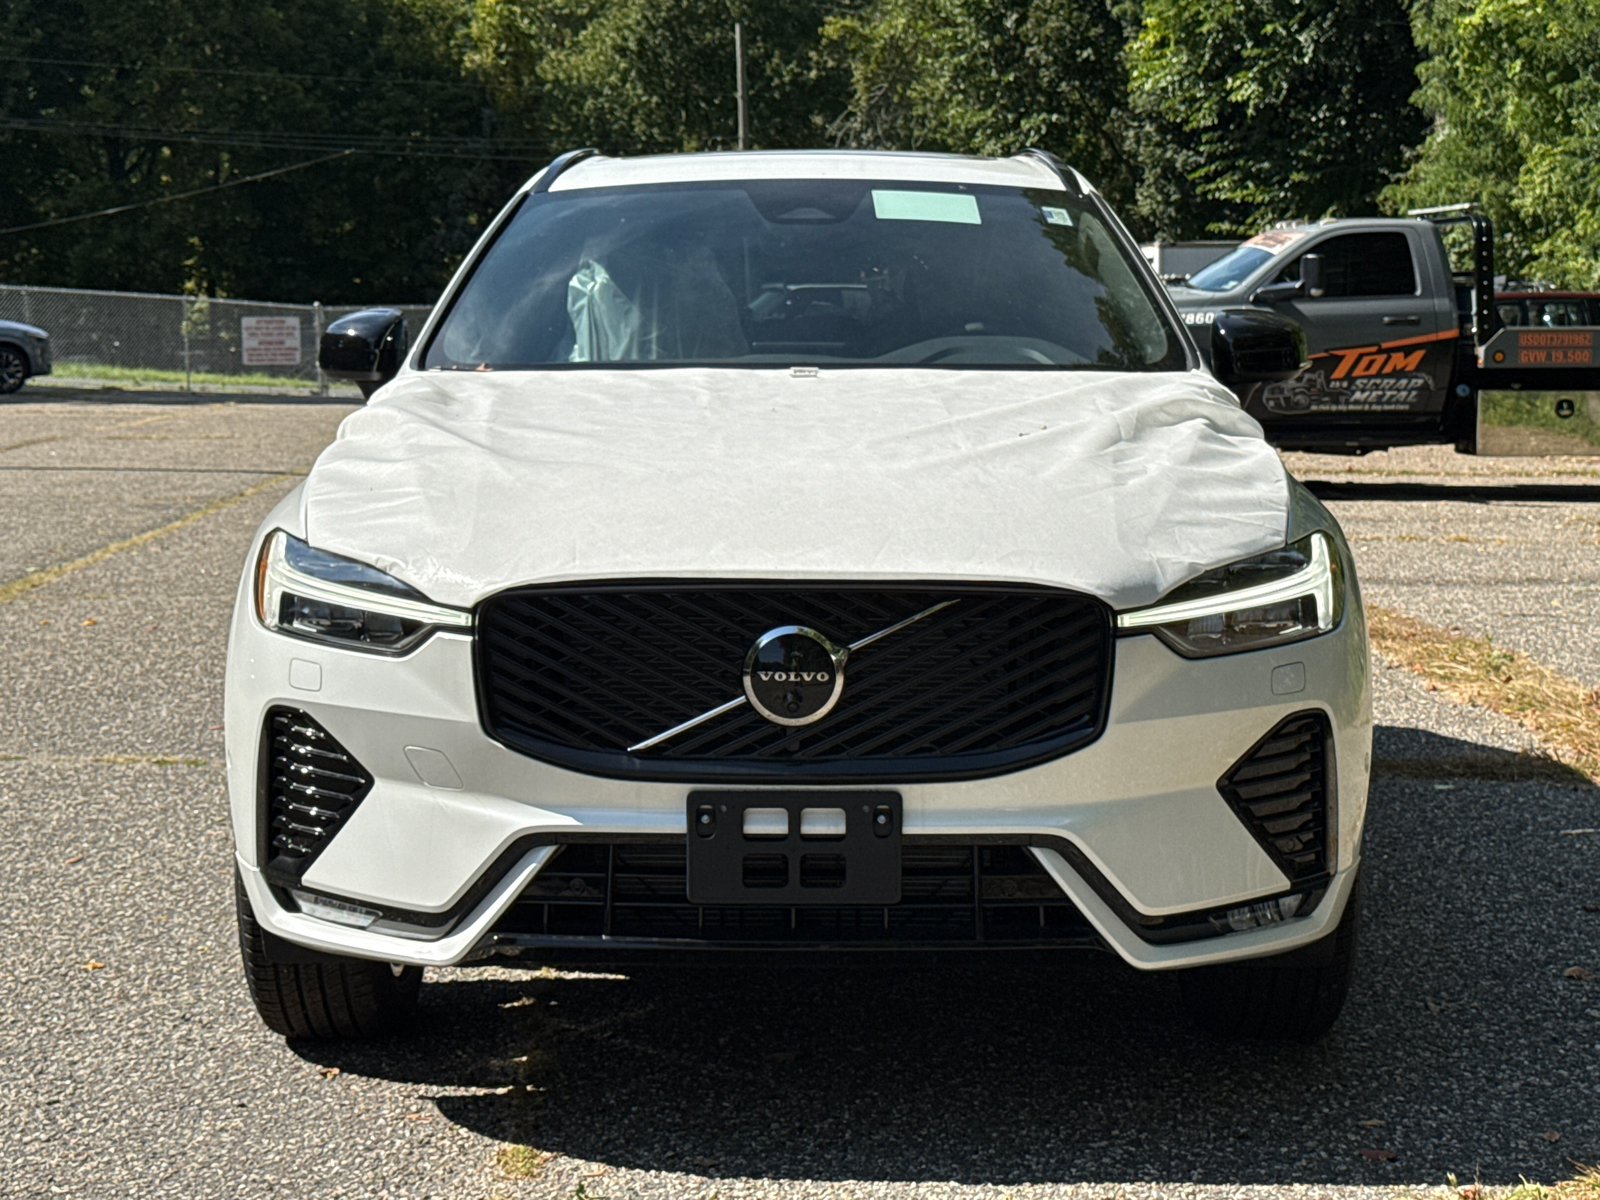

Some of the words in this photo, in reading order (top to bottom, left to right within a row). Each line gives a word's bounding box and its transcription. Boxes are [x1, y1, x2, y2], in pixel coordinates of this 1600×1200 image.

[1521, 350, 1547, 363] GVW
[1351, 378, 1425, 391] SCRAP
[1349, 390, 1419, 403] METAL
[757, 670, 830, 682] VOLVO
